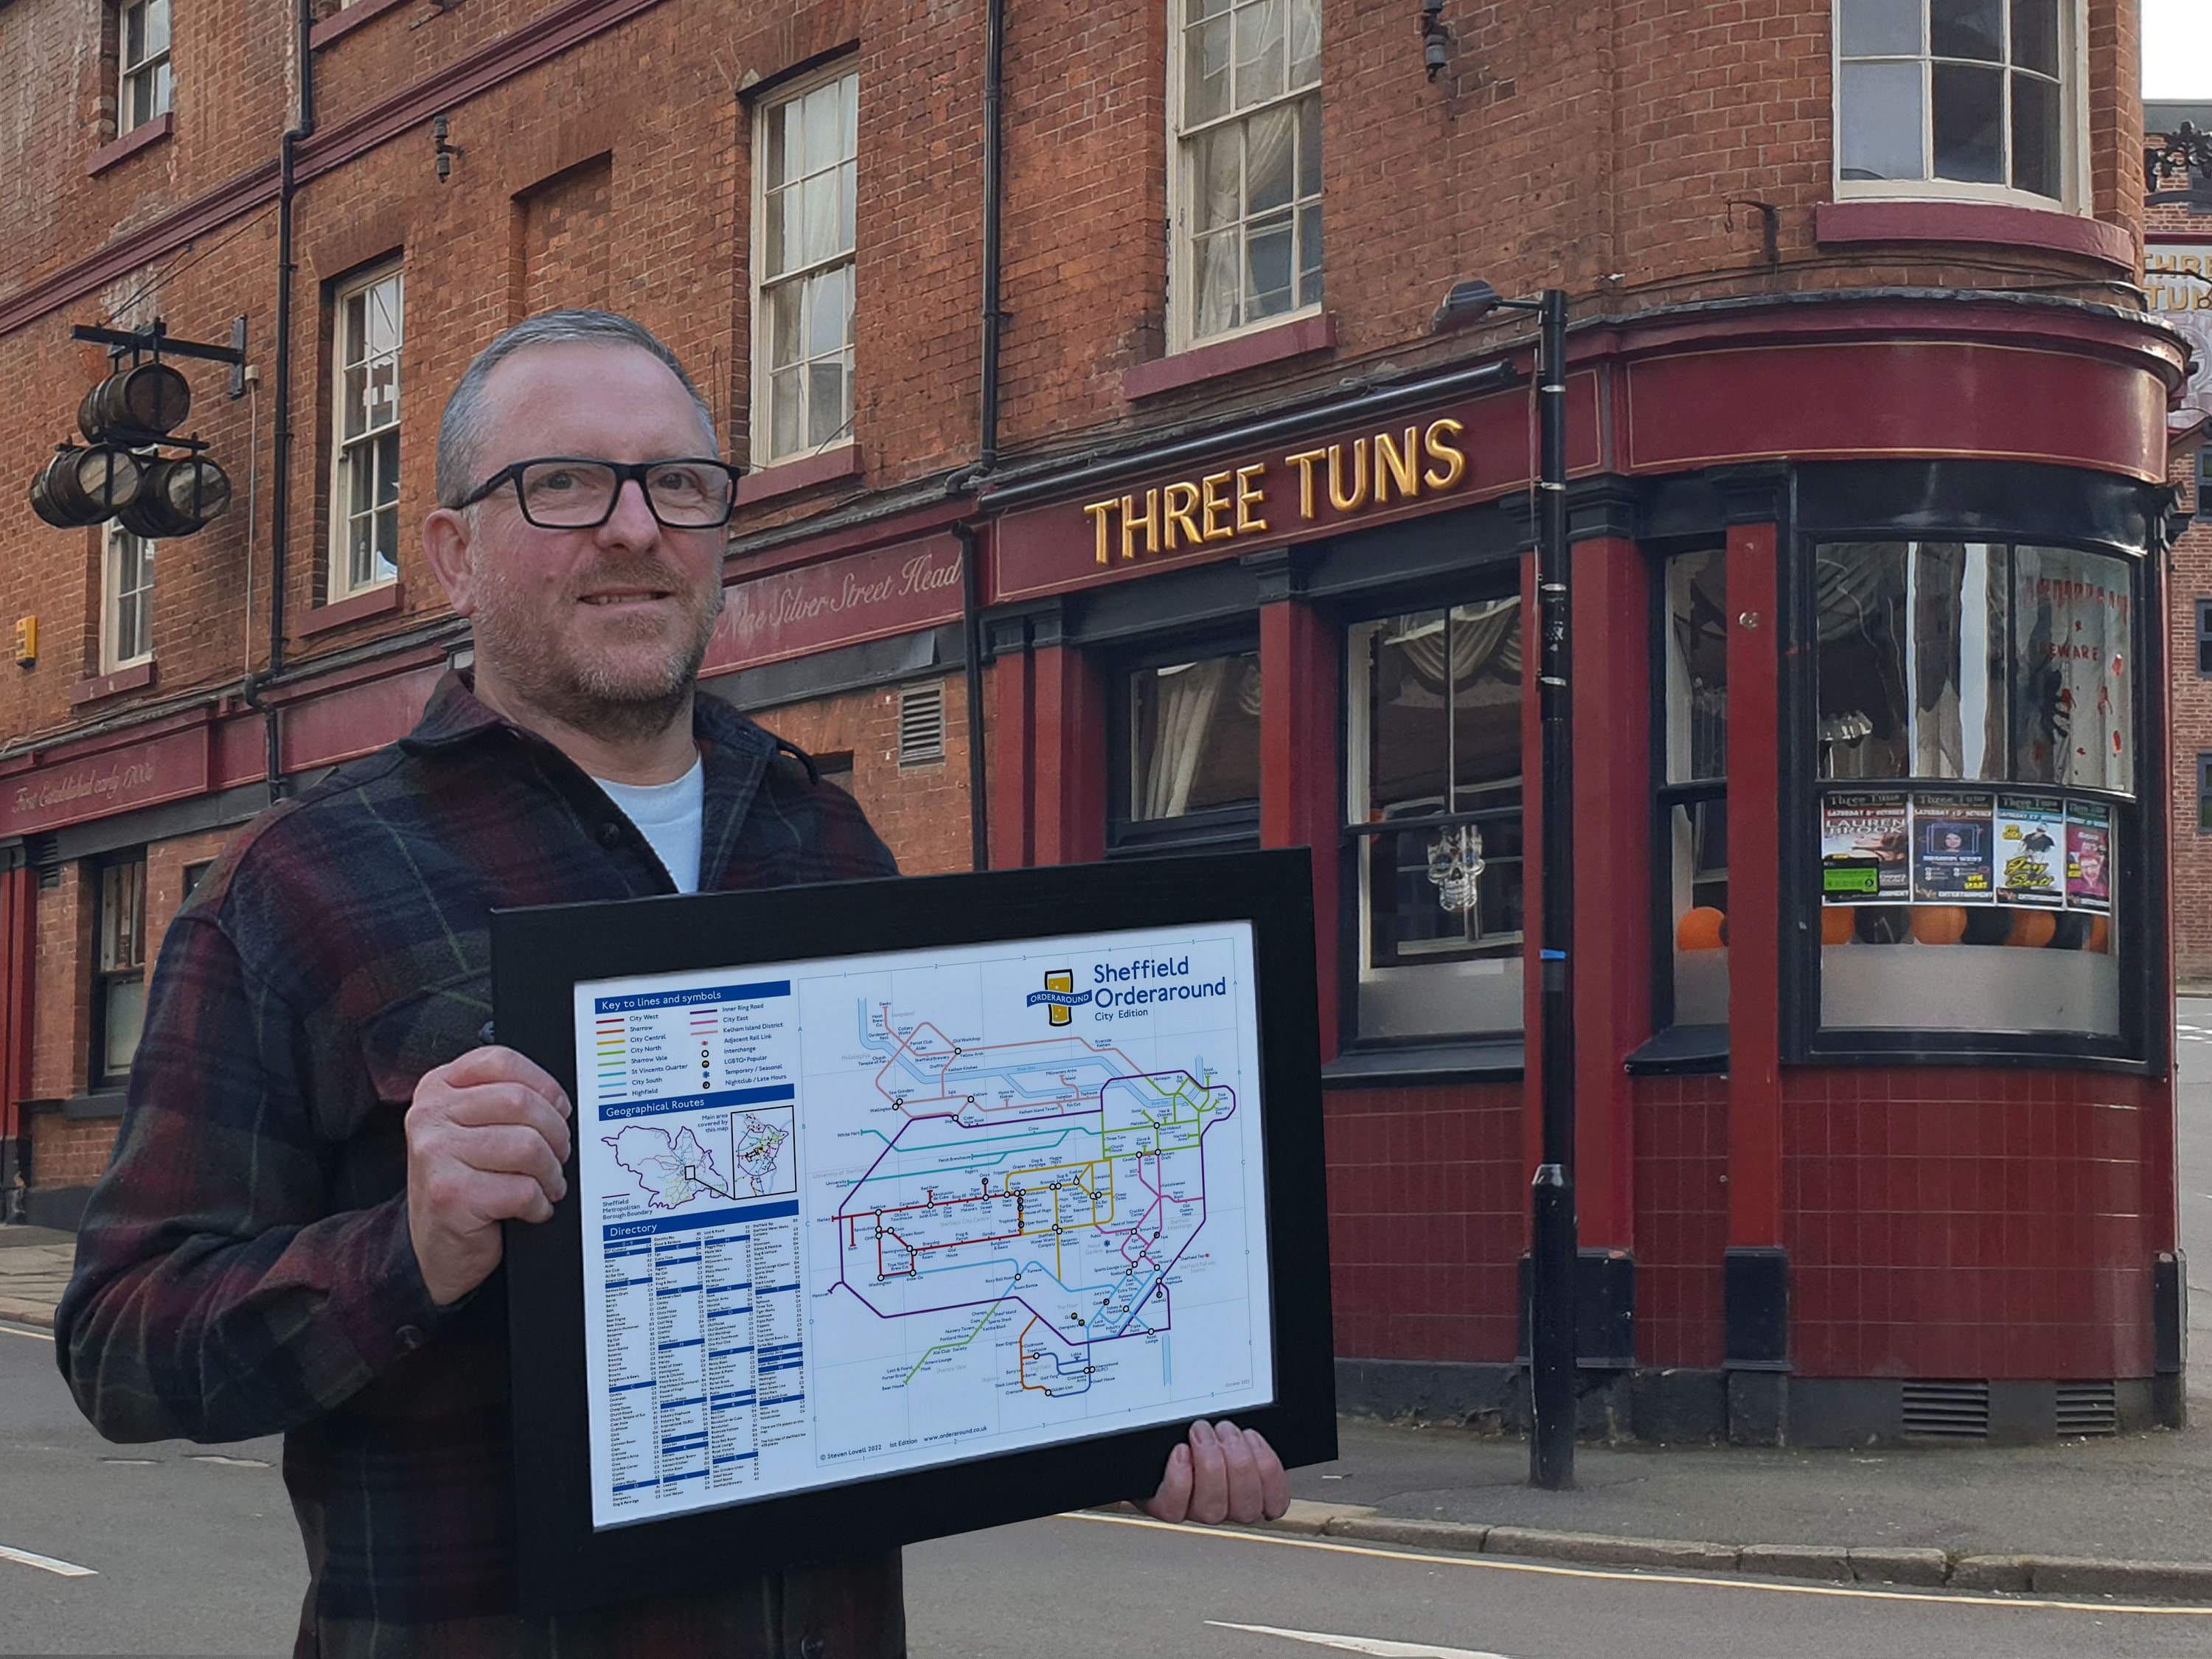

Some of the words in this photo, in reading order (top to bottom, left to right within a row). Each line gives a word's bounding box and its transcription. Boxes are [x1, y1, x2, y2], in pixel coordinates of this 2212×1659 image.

[2143, 252, 2212, 279] HR
[1082, 461, 1269, 566] THREE
[1284, 417, 1467, 521] TUNS
[768, 585, 829, 627] Silver
[830, 572, 894, 612] Street
[898, 550, 963, 596] Head
[1826, 818, 1905, 828] LAUREN
[1093, 956, 1189, 984] Sheffield
[1030, 992, 1089, 1004] ORDERAROUND
[1094, 977, 1226, 1008] Orderaround
[602, 1001, 621, 1012] Key
[638, 997, 660, 1007] lines
[664, 994, 680, 1004] and
[683, 991, 721, 1004] symbols
[1095, 1012, 1113, 1021] City
[1118, 1008, 1148, 1018] Edition
[724, 1046, 757, 1054] Interchange
[746, 1055, 767, 1063] Popular
[726, 1068, 754, 1077] Temporary
[726, 1078, 751, 1086] Nightclub
[632, 1088, 658, 1096] Highfield
[606, 1102, 669, 1118] Geographical
[672, 1099, 705, 1108] Routes
[603, 1203, 640, 1214] Metropolitan
[603, 1212, 625, 1220] Borough
[627, 1208, 653, 1217] Boundary
[611, 1222, 657, 1237] Directory
[827, 1451, 847, 1460] Steven
[898, 1439, 918, 1447] Edition
[923, 1426, 987, 1442] www.orderaround.co.uk
